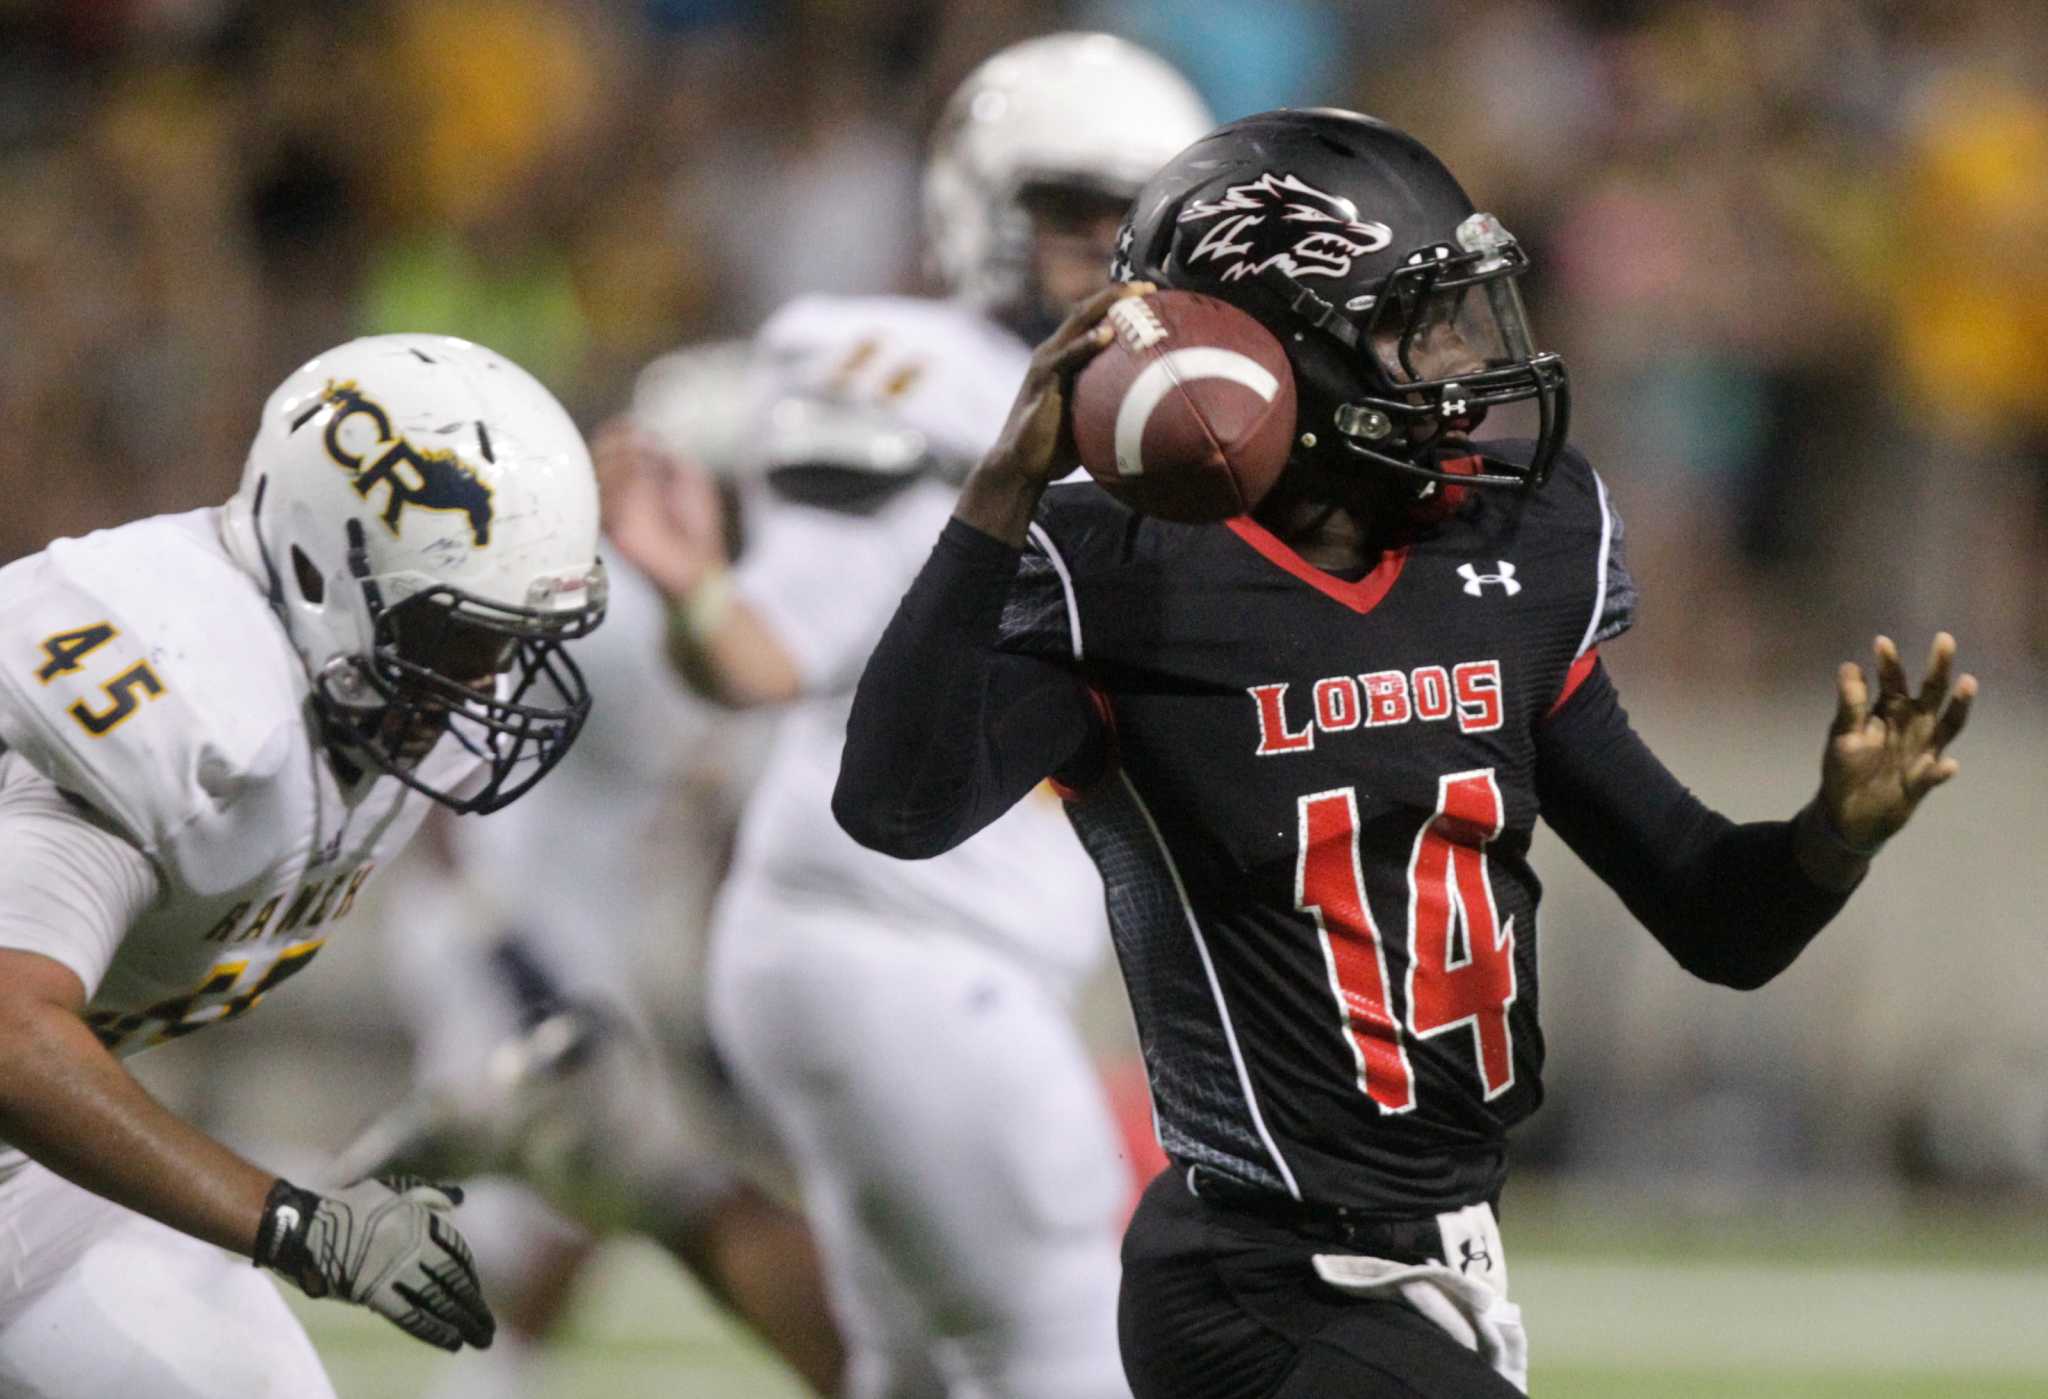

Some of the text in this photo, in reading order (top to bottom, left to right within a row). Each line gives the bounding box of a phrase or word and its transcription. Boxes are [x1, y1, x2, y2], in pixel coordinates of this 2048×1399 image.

[322, 386, 428, 538] CR
[33, 620, 168, 740] 45
[1247, 660, 1503, 756] LOBOS
[1295, 768, 1518, 1115] 14
